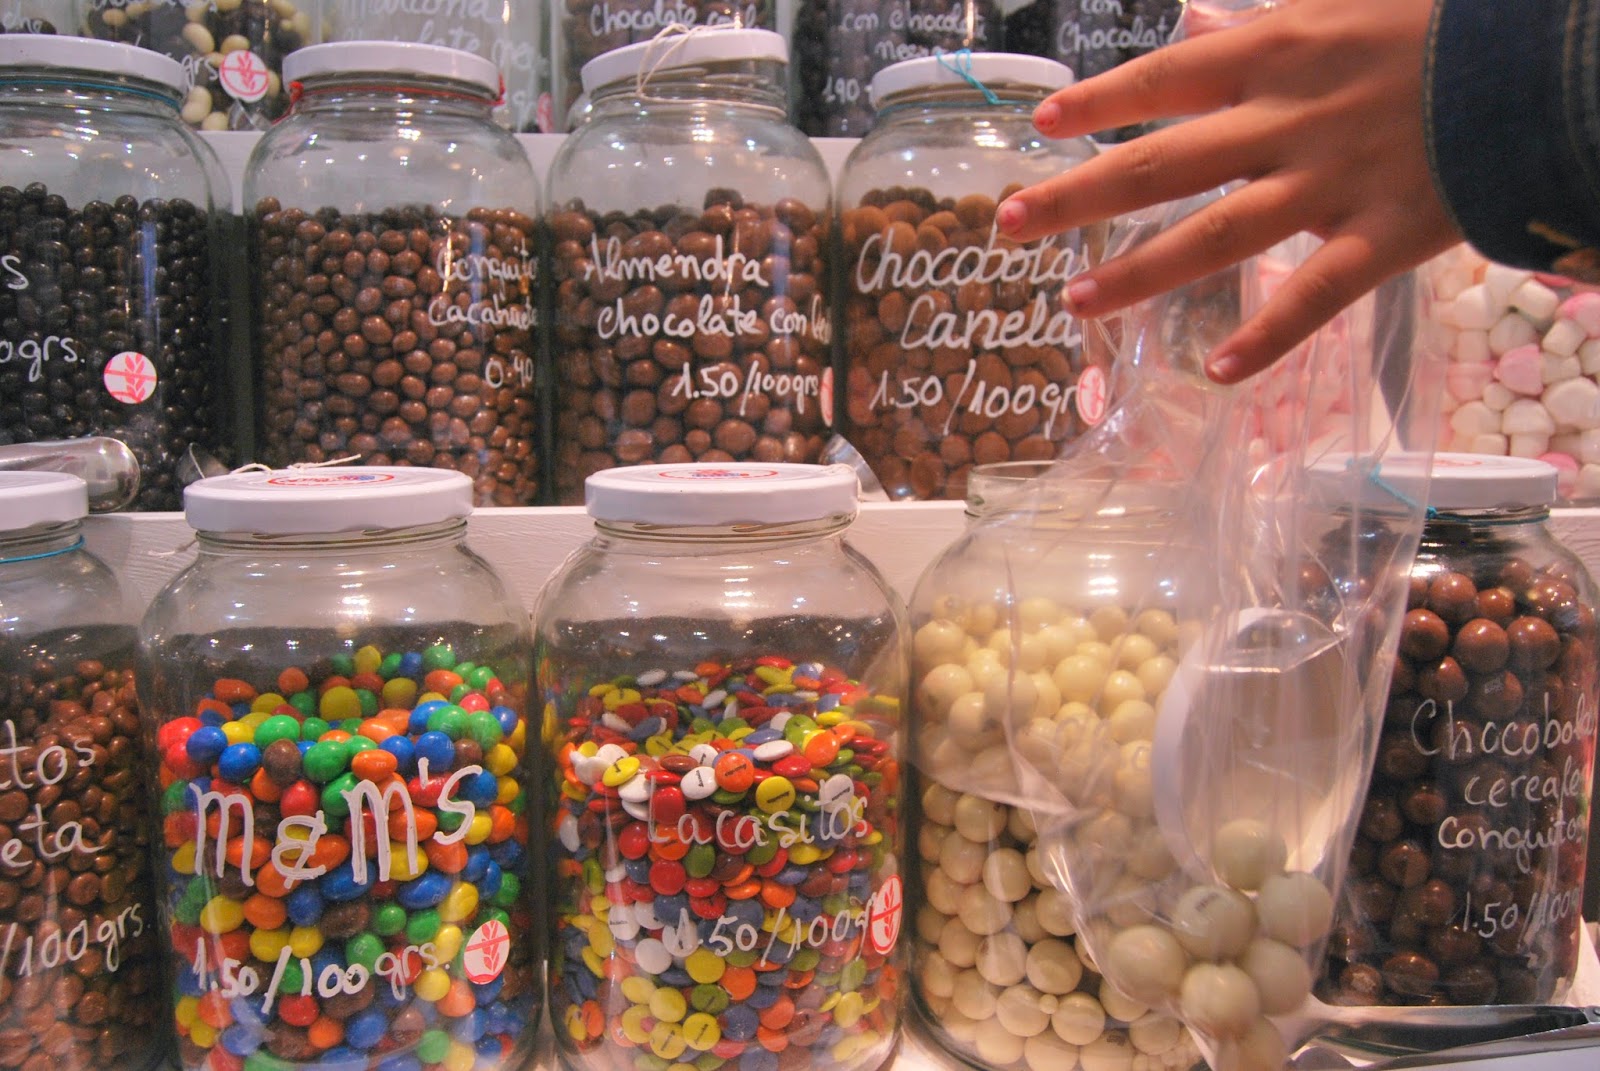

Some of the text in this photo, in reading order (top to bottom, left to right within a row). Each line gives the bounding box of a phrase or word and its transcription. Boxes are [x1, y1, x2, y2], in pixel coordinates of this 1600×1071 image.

[840, 12, 880, 32] con
[584, 233, 769, 287] Almendra
[770, 307, 807, 336] con
[900, 291, 1081, 349] Canela
[1464, 754, 1587, 807] cereale
